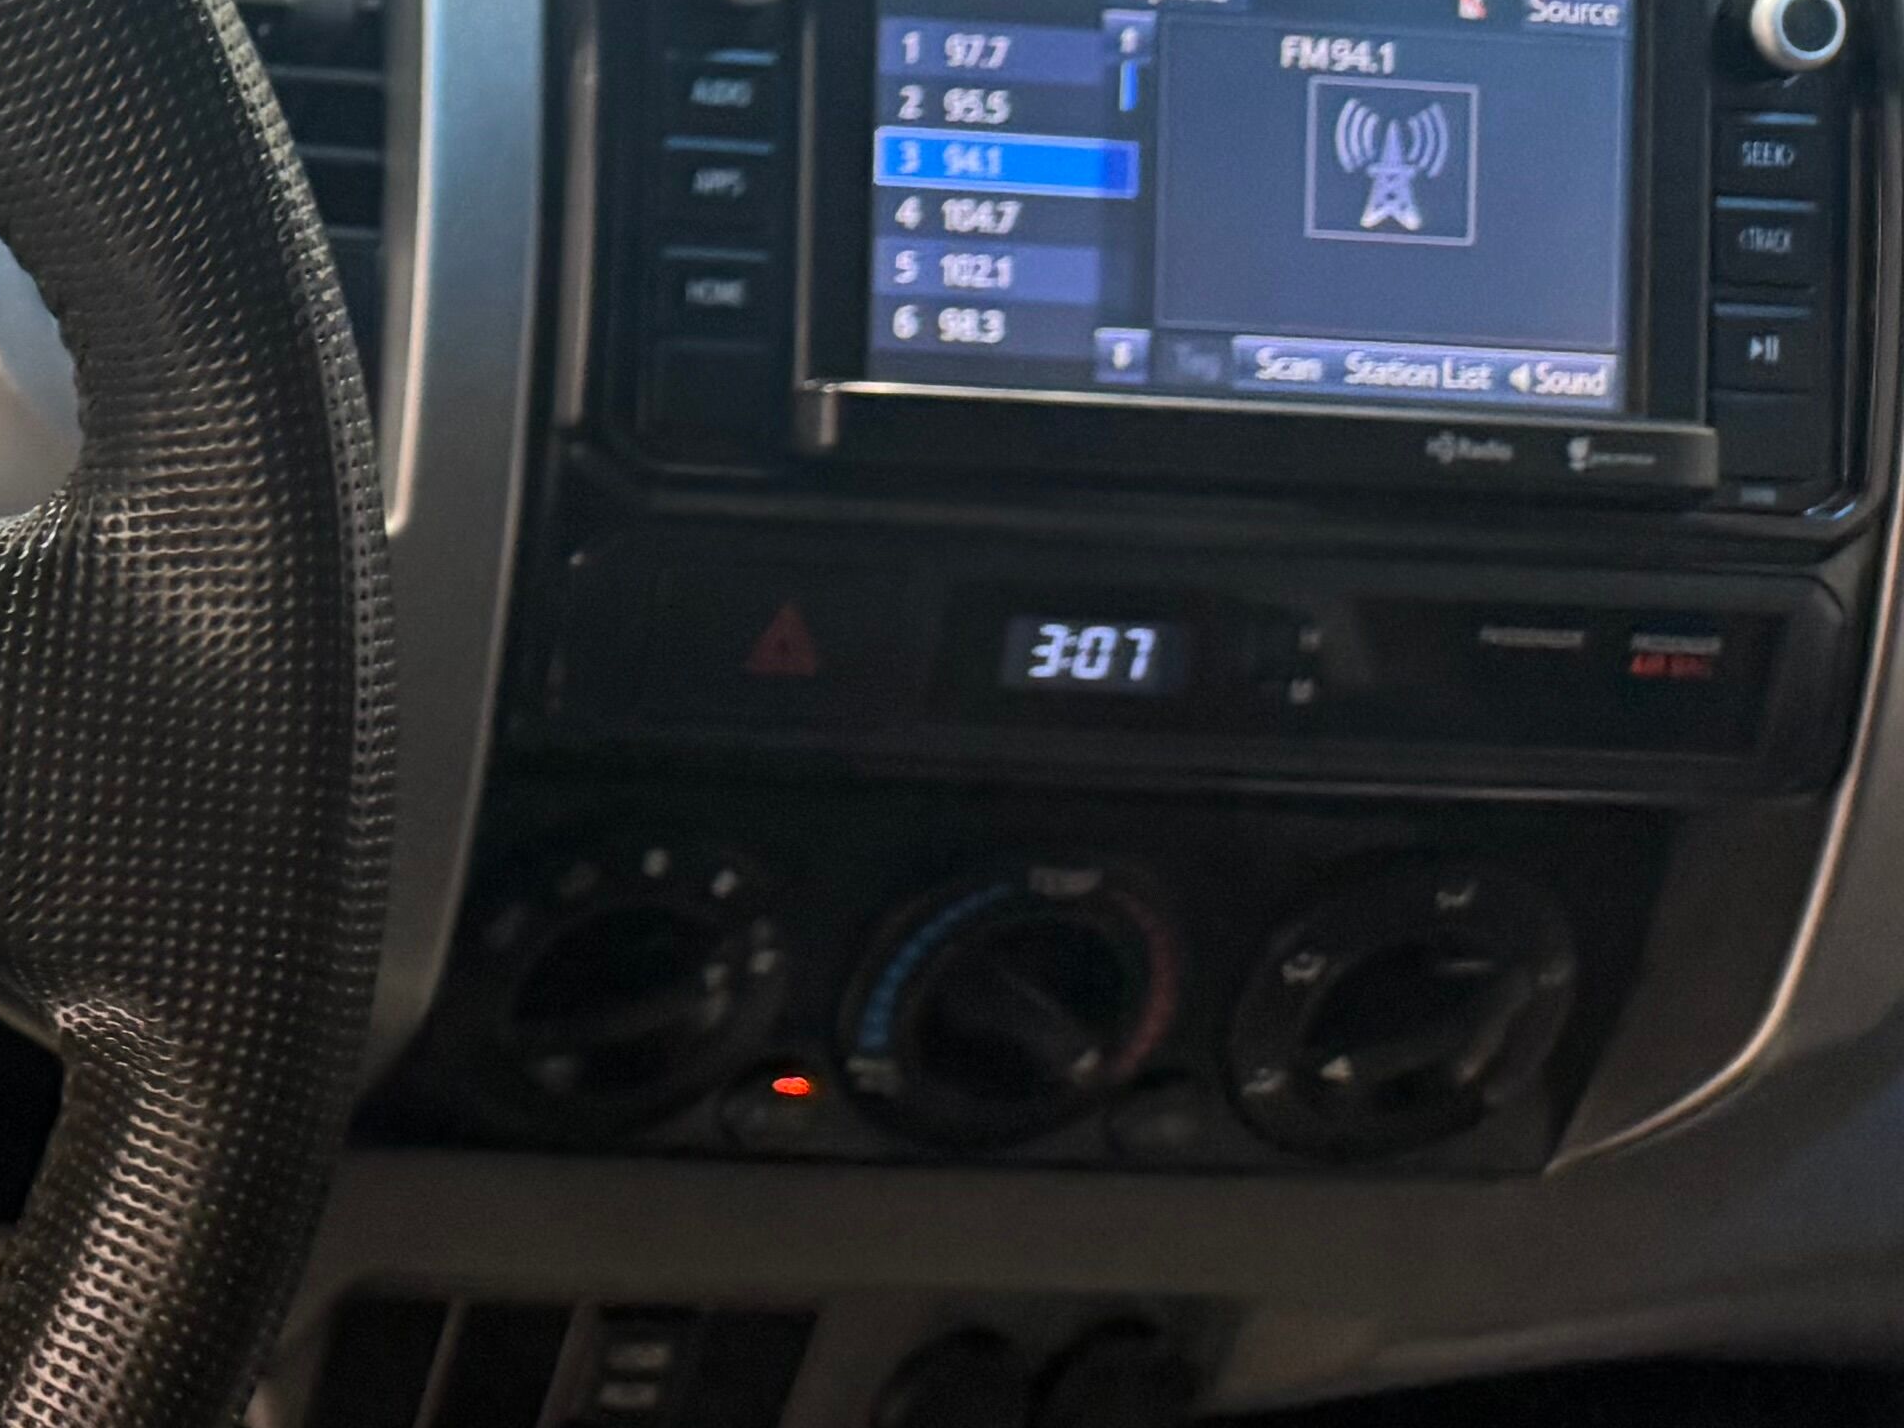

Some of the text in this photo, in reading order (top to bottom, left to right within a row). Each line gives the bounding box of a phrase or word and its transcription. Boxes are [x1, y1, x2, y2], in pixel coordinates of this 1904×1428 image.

[901, 30, 1012, 69] 1 97.7
[898, 84, 1012, 124] 2 95.5
[898, 140, 921, 174] 3
[894, 195, 1023, 235] 4 104.7
[894, 250, 1015, 289] 5 102.1
[892, 304, 1006, 344] 6 98.3
[1255, 345, 1608, 396] Scan Station List Sound
[1028, 623, 1157, 682] 3:07
